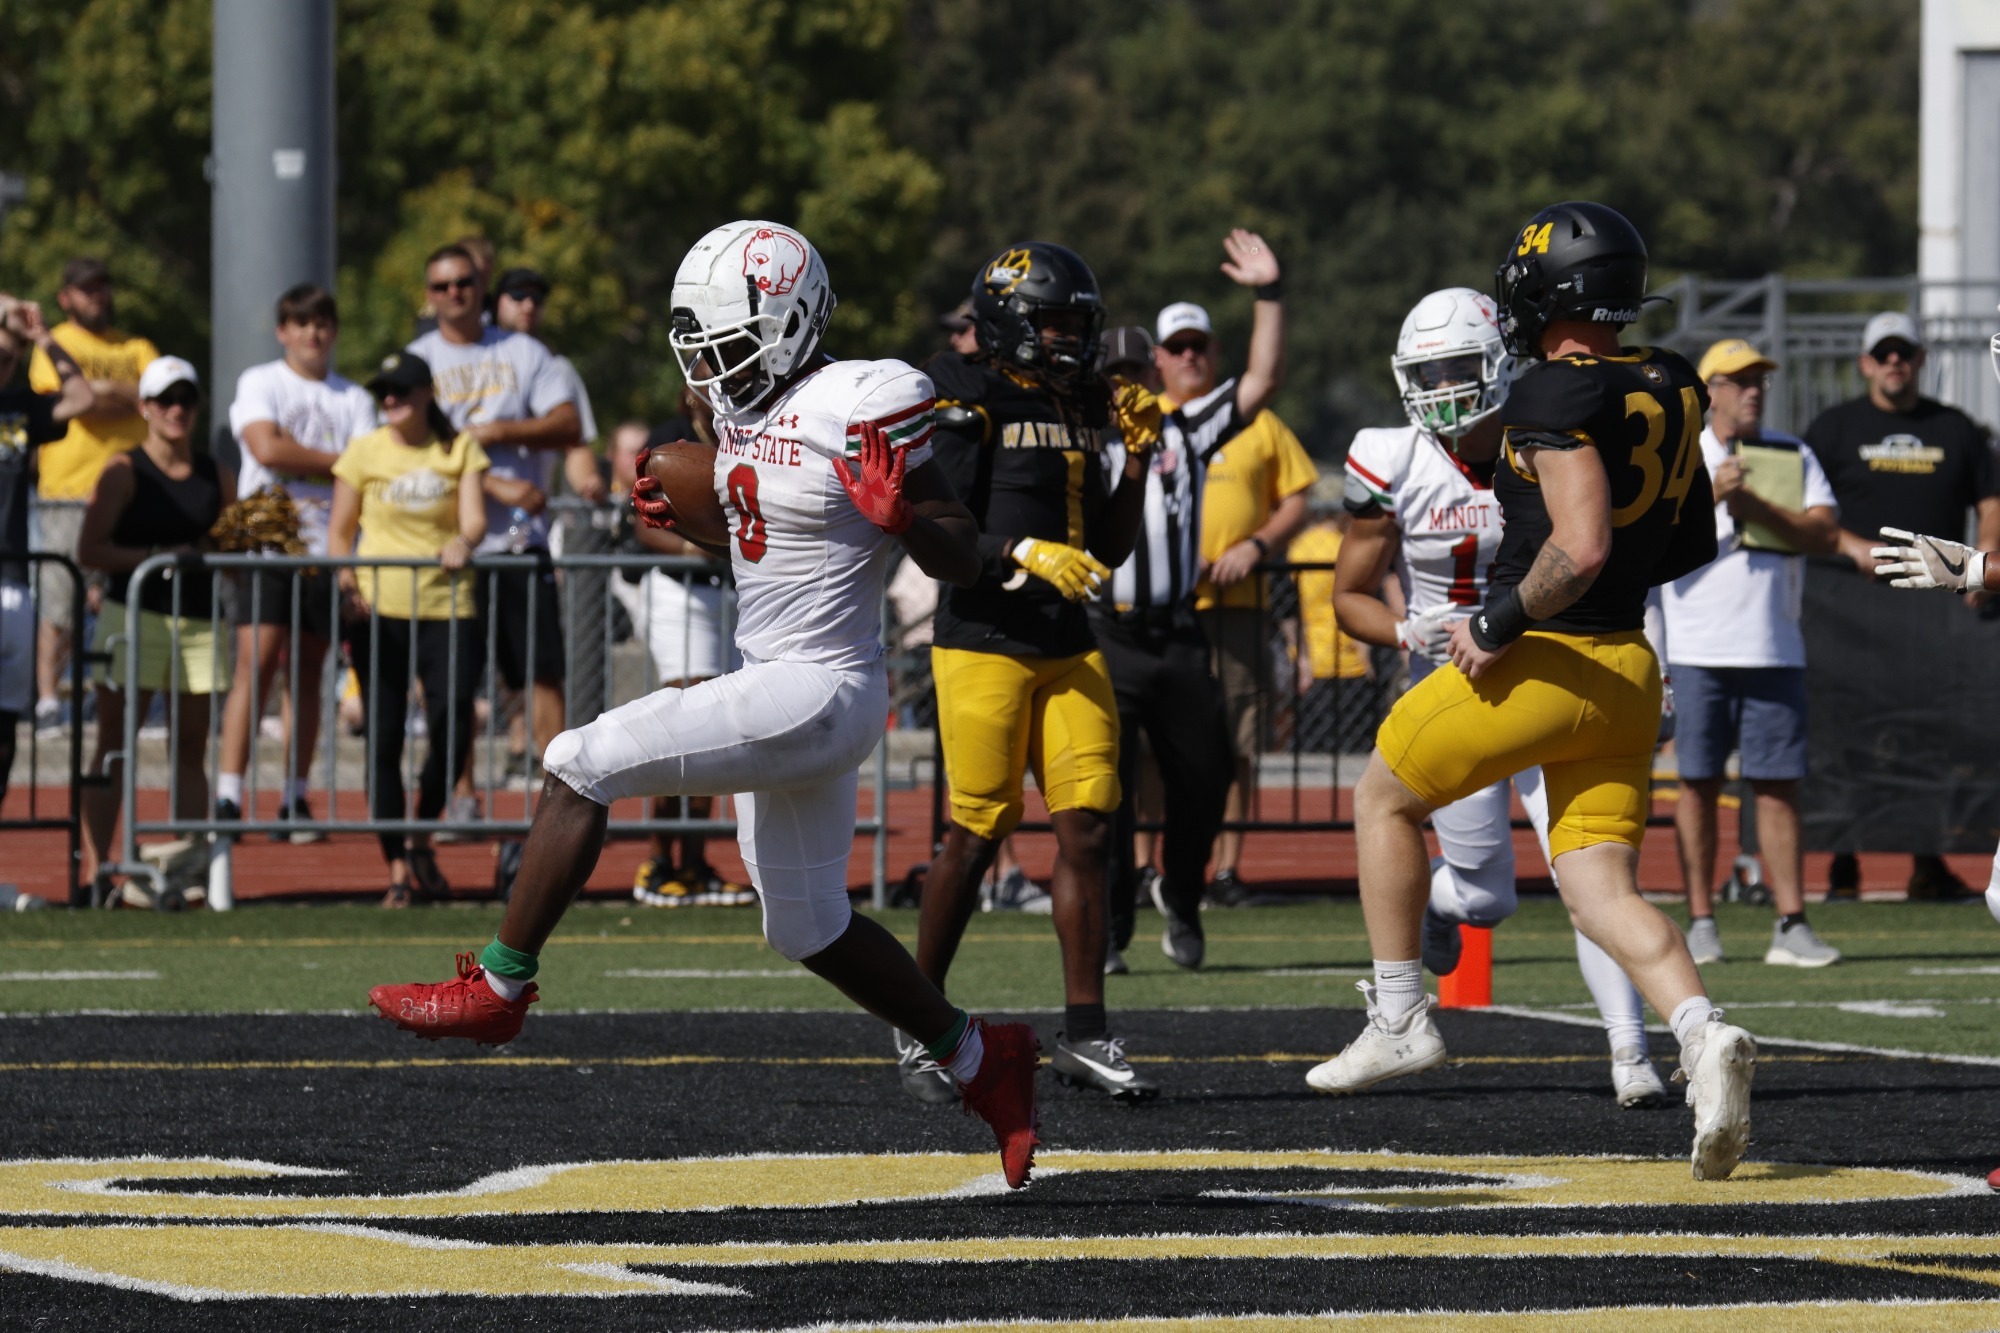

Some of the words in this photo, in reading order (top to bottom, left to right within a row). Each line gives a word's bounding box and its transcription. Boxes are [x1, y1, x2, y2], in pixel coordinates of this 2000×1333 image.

[1517, 222, 1553, 257] 34
[719, 426, 753, 458] INOT
[752, 432, 803, 467] STATE
[1002, 421, 1072, 448] WAYNE
[1611, 385, 1703, 528] 34
[727, 462, 768, 565] 0
[1062, 450, 1086, 548] 1
[1429, 505, 1490, 530] MINOT
